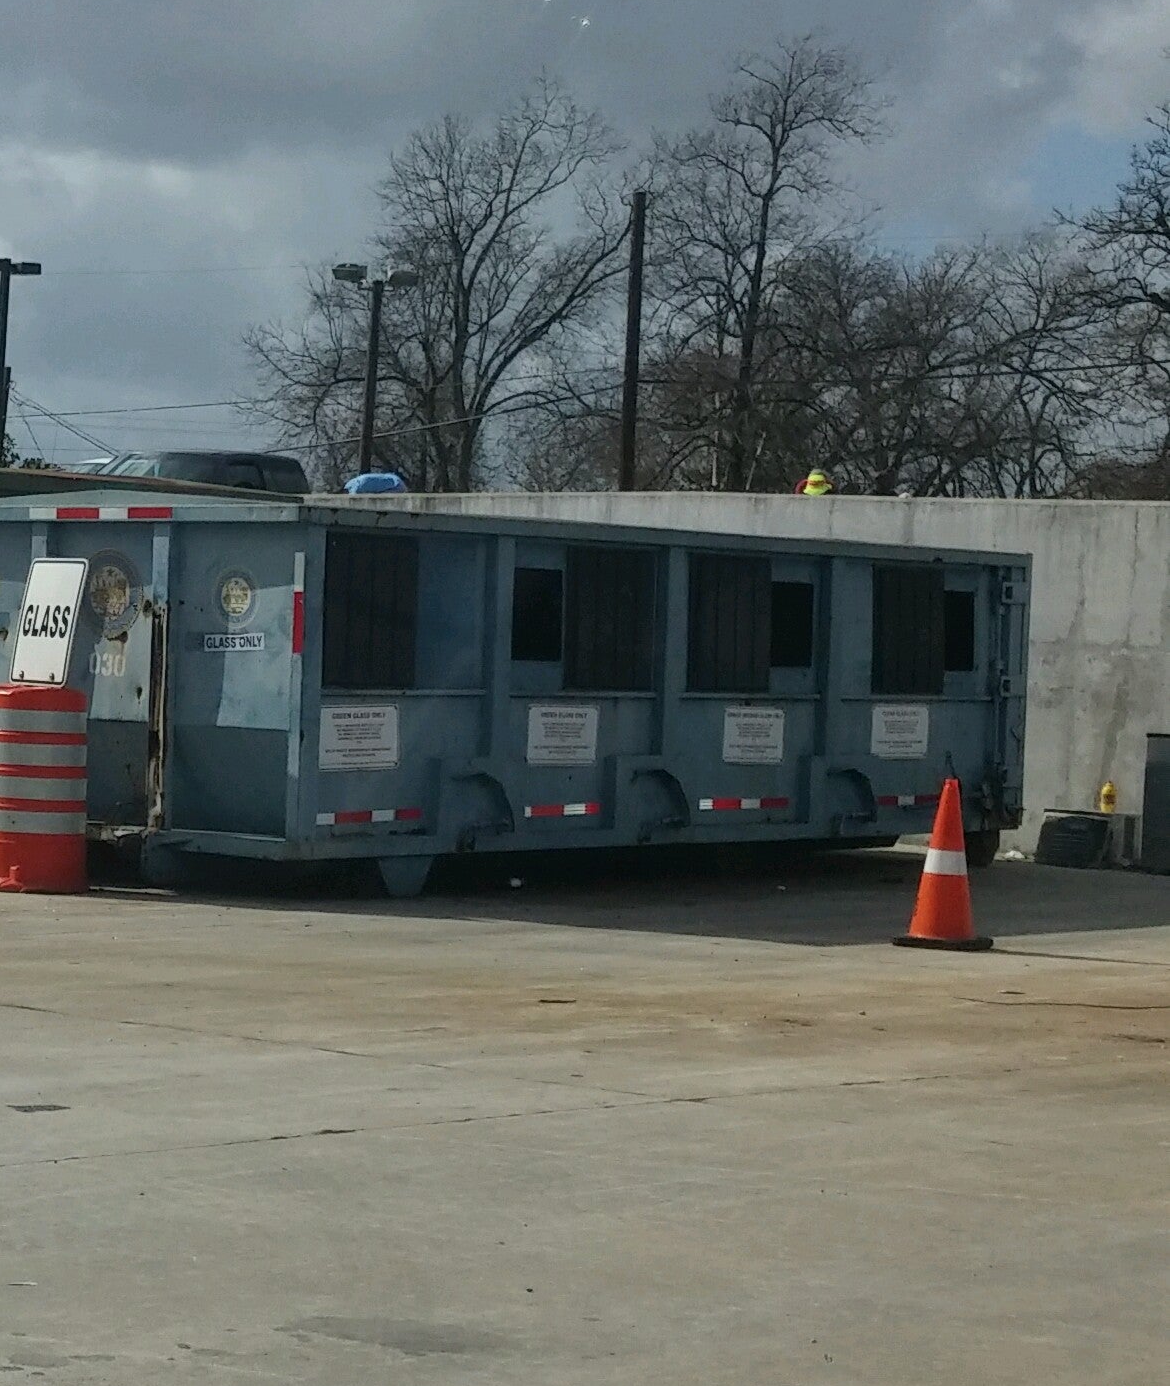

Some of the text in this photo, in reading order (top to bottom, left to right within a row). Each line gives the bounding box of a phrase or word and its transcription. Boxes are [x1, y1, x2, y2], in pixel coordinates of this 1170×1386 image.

[22, 604, 71, 639] GLASS
[206, 635, 262, 649] GLASS ONLY
